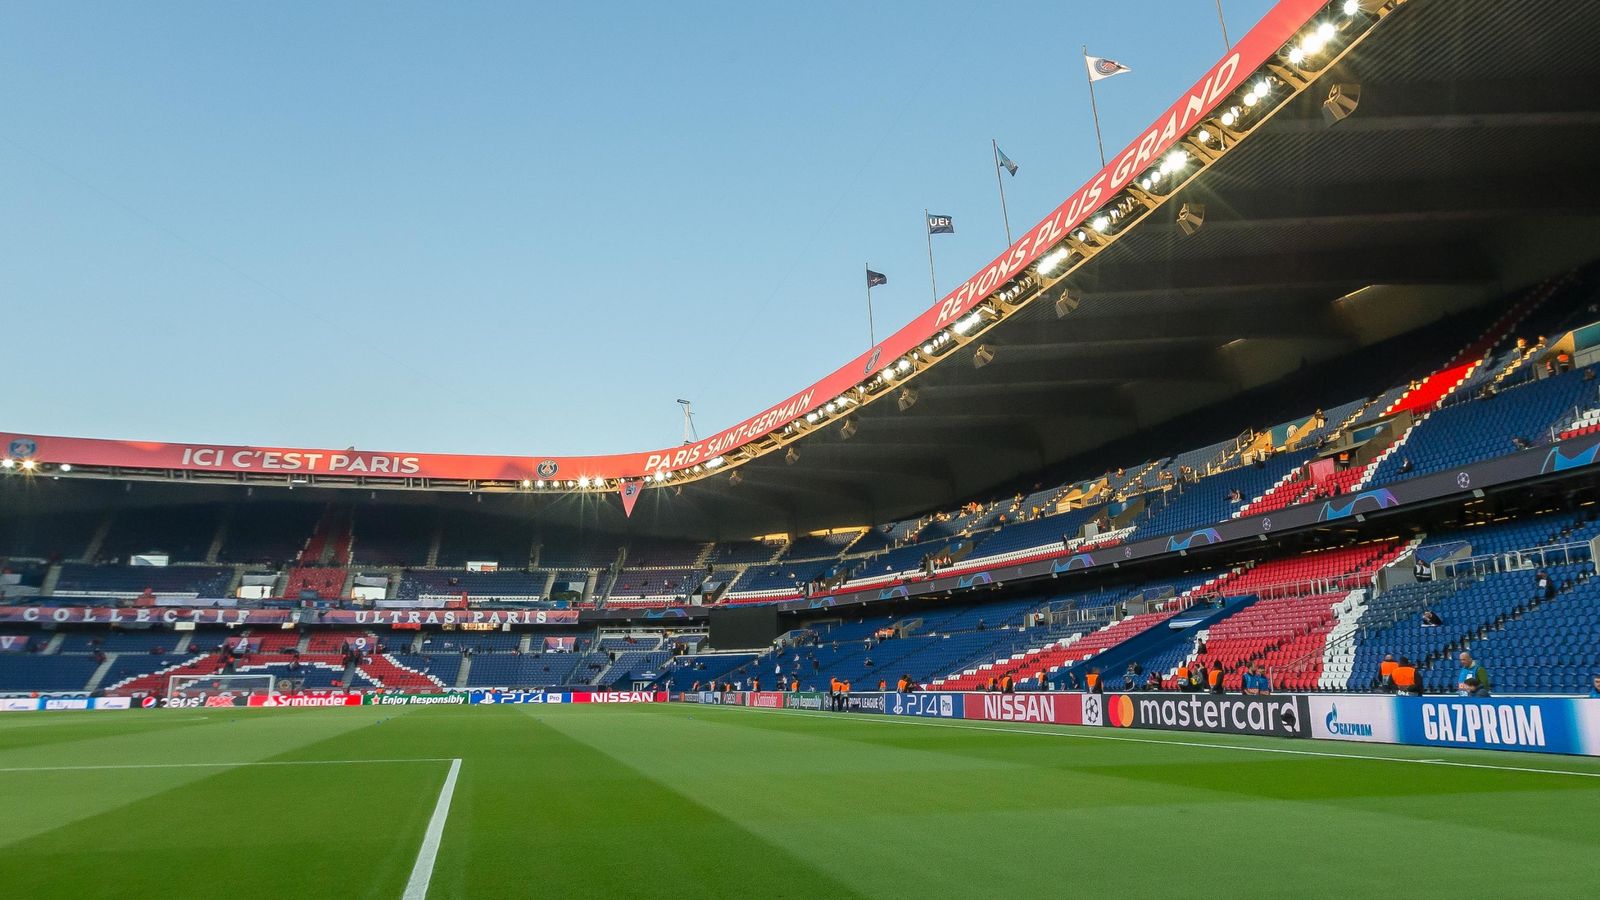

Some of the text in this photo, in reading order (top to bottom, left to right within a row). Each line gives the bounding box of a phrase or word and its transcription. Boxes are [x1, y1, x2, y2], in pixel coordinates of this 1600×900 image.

[935, 52, 1240, 327] RÊVONS PLUS GRAND
[644, 388, 815, 471] PARIS SAINT-GERMAIN
[182, 448, 224, 467] ICI
[329, 454, 420, 474] PARIS
[355, 611, 456, 624] ULTRAS
[473, 611, 548, 624] PARIS
[355, 637, 367, 650] 9
[278, 695, 347, 707] Santander
[382, 695, 465, 705] Enjoy Responsibly
[501, 693, 544, 704] PS4
[591, 692, 654, 702] NISSAN
[861, 698, 879, 709] LEAGUE
[906, 694, 938, 716] PS4
[984, 694, 1055, 722] NISSAN
[1140, 694, 1301, 733] mastercard
[1339, 722, 1373, 736] GAZPROM
[1422, 703, 1546, 747] GAZPROM
